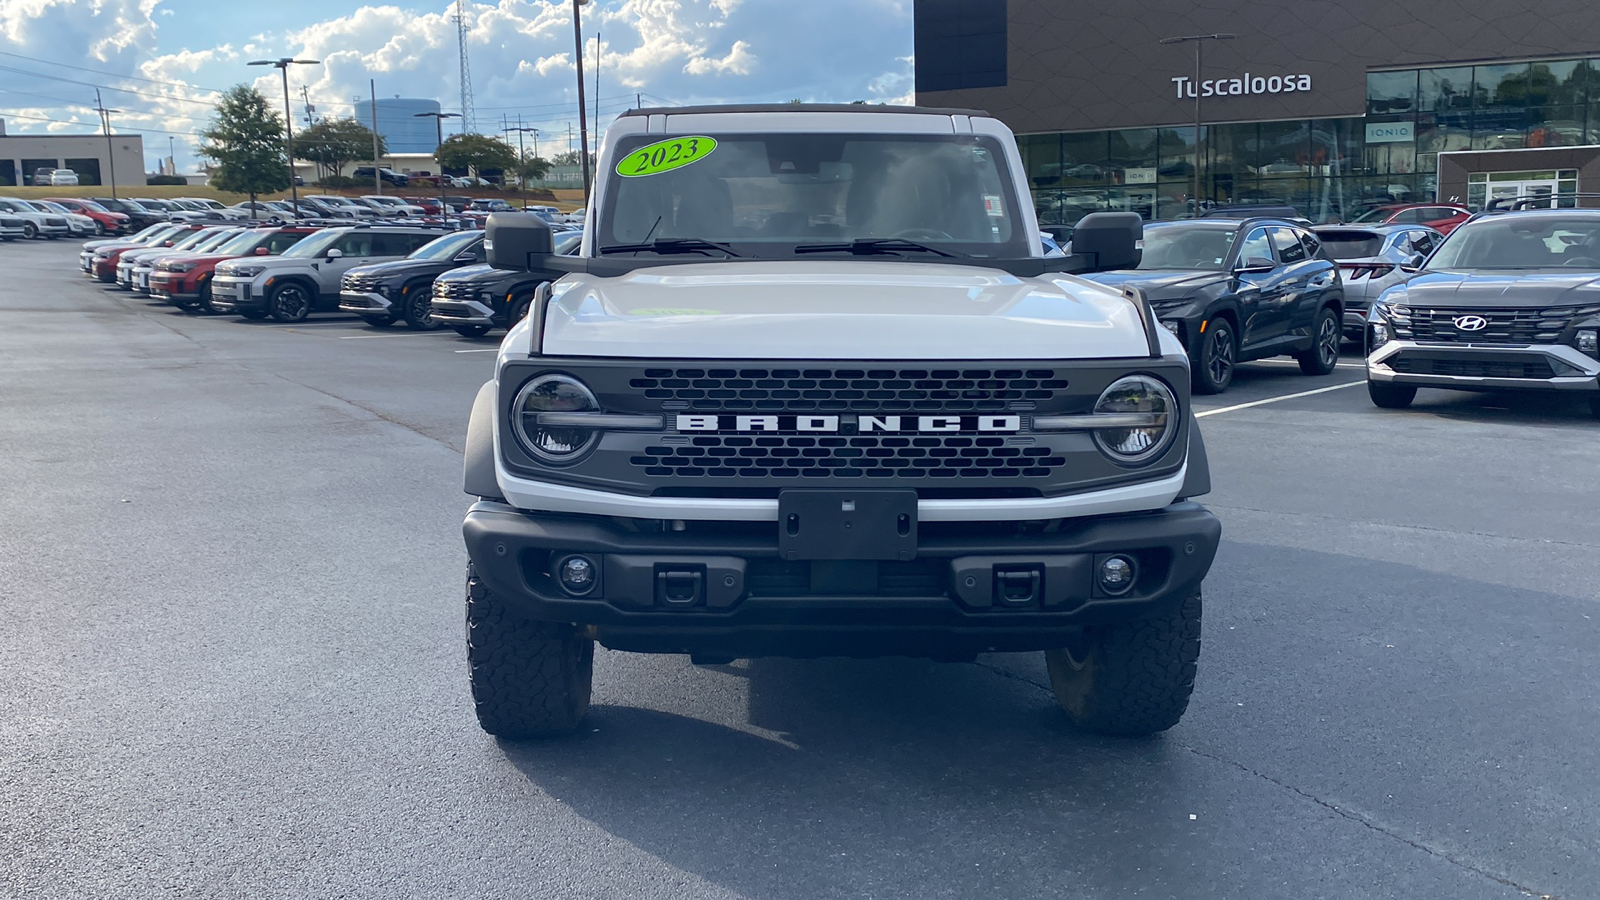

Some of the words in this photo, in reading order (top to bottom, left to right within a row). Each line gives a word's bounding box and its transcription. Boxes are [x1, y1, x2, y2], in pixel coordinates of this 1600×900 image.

[1171, 72, 1312, 99] Tuscaloosa
[633, 139, 699, 173] 2023
[676, 414, 1021, 432] BRONCO
